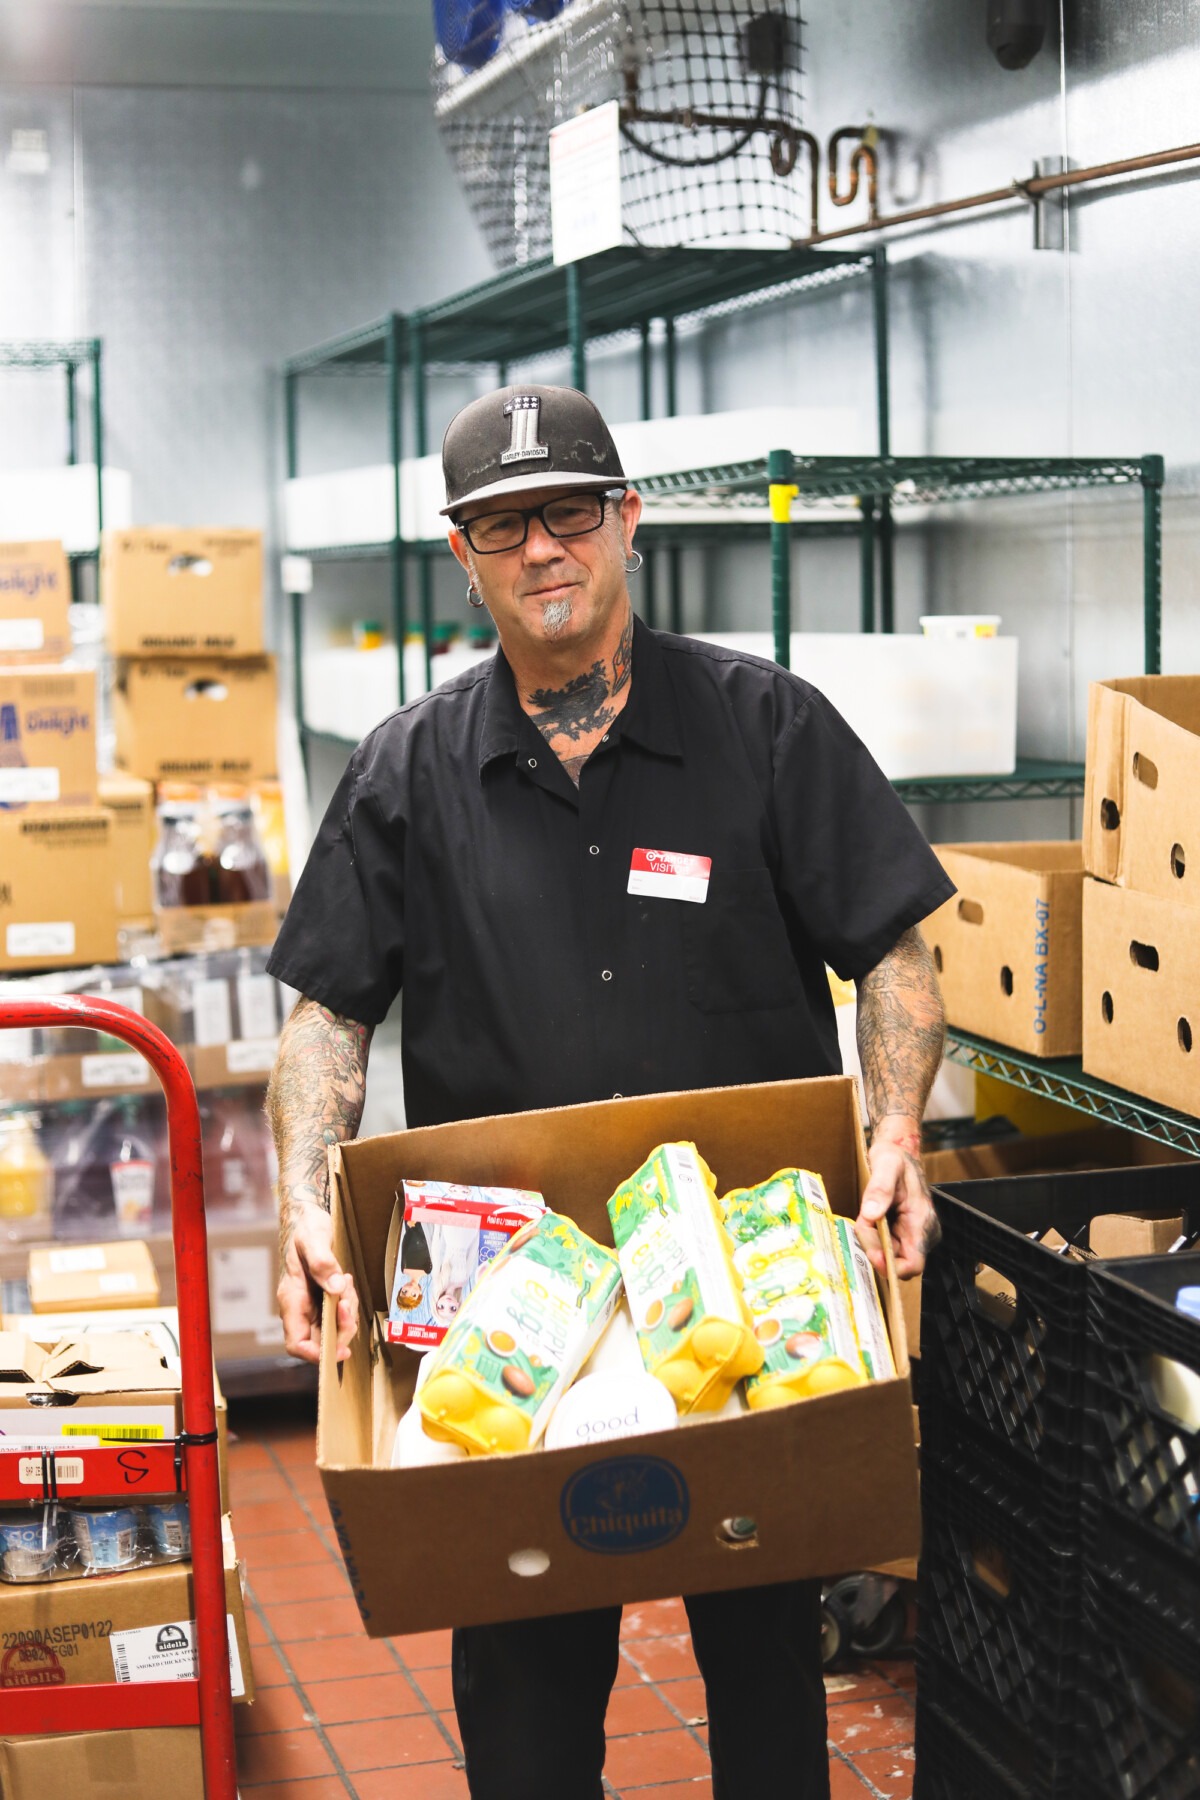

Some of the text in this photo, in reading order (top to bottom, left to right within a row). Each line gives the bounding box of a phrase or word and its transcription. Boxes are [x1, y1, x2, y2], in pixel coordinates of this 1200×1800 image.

[576, 1405, 640, 1444] good
[158, 1641, 187, 1651] aidells
[4, 1671, 61, 1688] aidells
